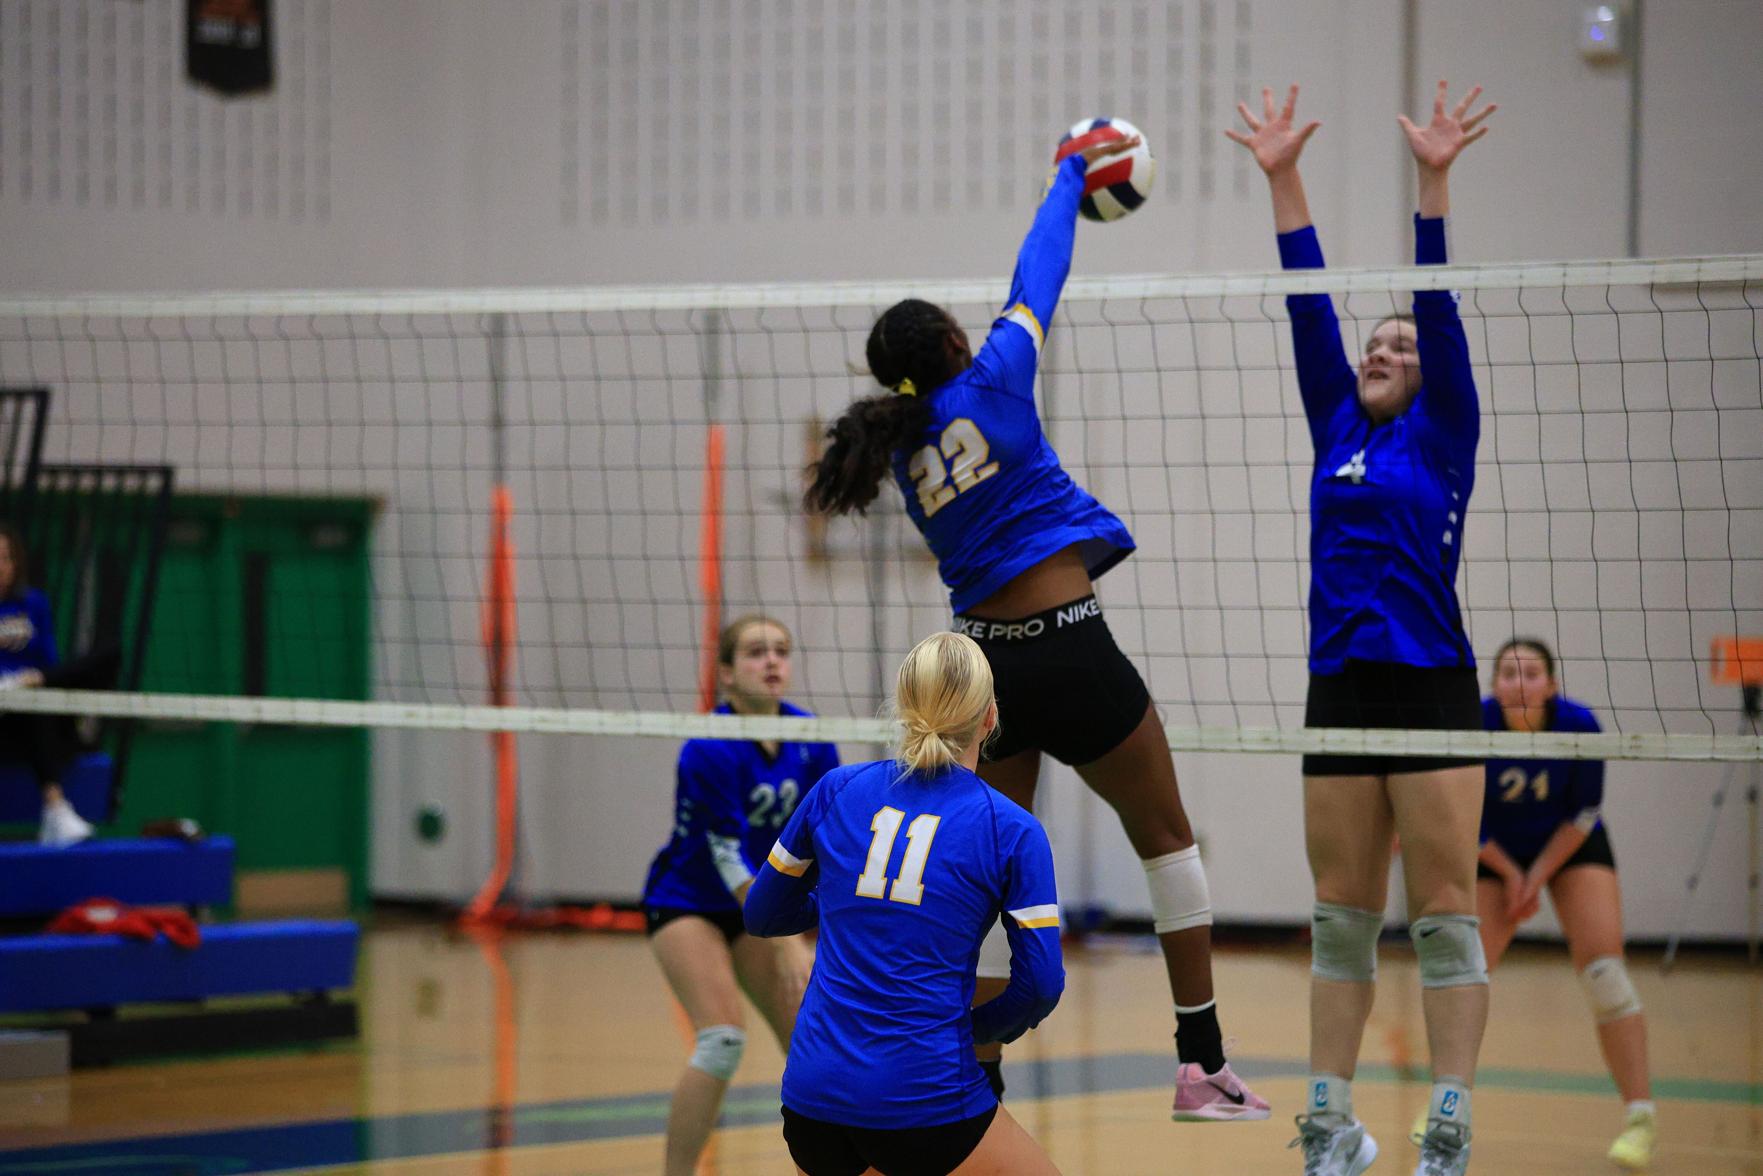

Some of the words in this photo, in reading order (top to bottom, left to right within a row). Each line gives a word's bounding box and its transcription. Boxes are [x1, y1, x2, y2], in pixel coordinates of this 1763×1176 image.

[908, 417, 1000, 518] 22
[988, 618, 1045, 641] PRO
[1056, 598, 1100, 629] NIKE
[748, 777, 799, 829] 23
[855, 805, 942, 906] 11
